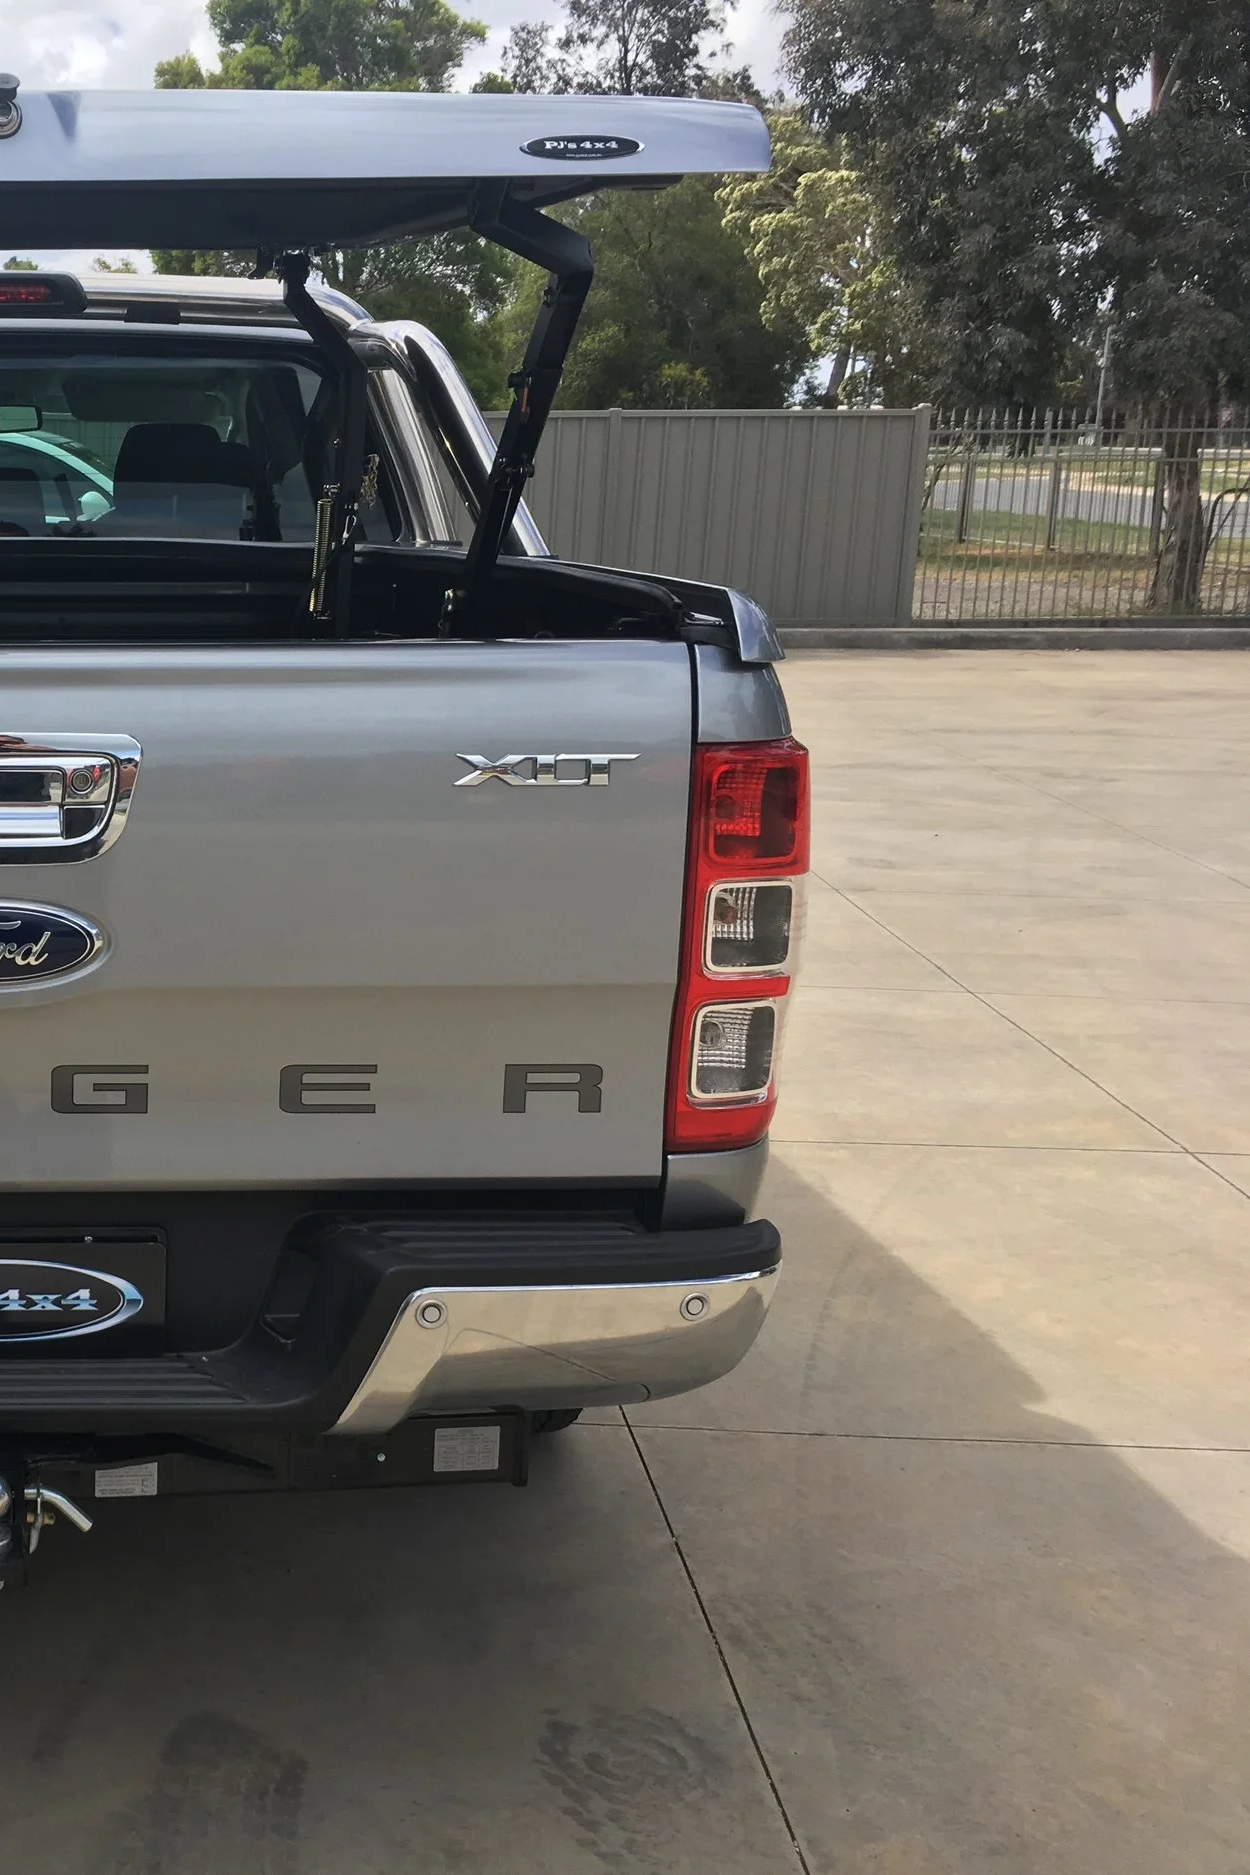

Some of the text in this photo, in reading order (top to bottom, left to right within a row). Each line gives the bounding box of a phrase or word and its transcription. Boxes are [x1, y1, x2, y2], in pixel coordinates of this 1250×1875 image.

[543, 140, 618, 149] PJ's 4x4
[453, 753, 642, 786] XLT
